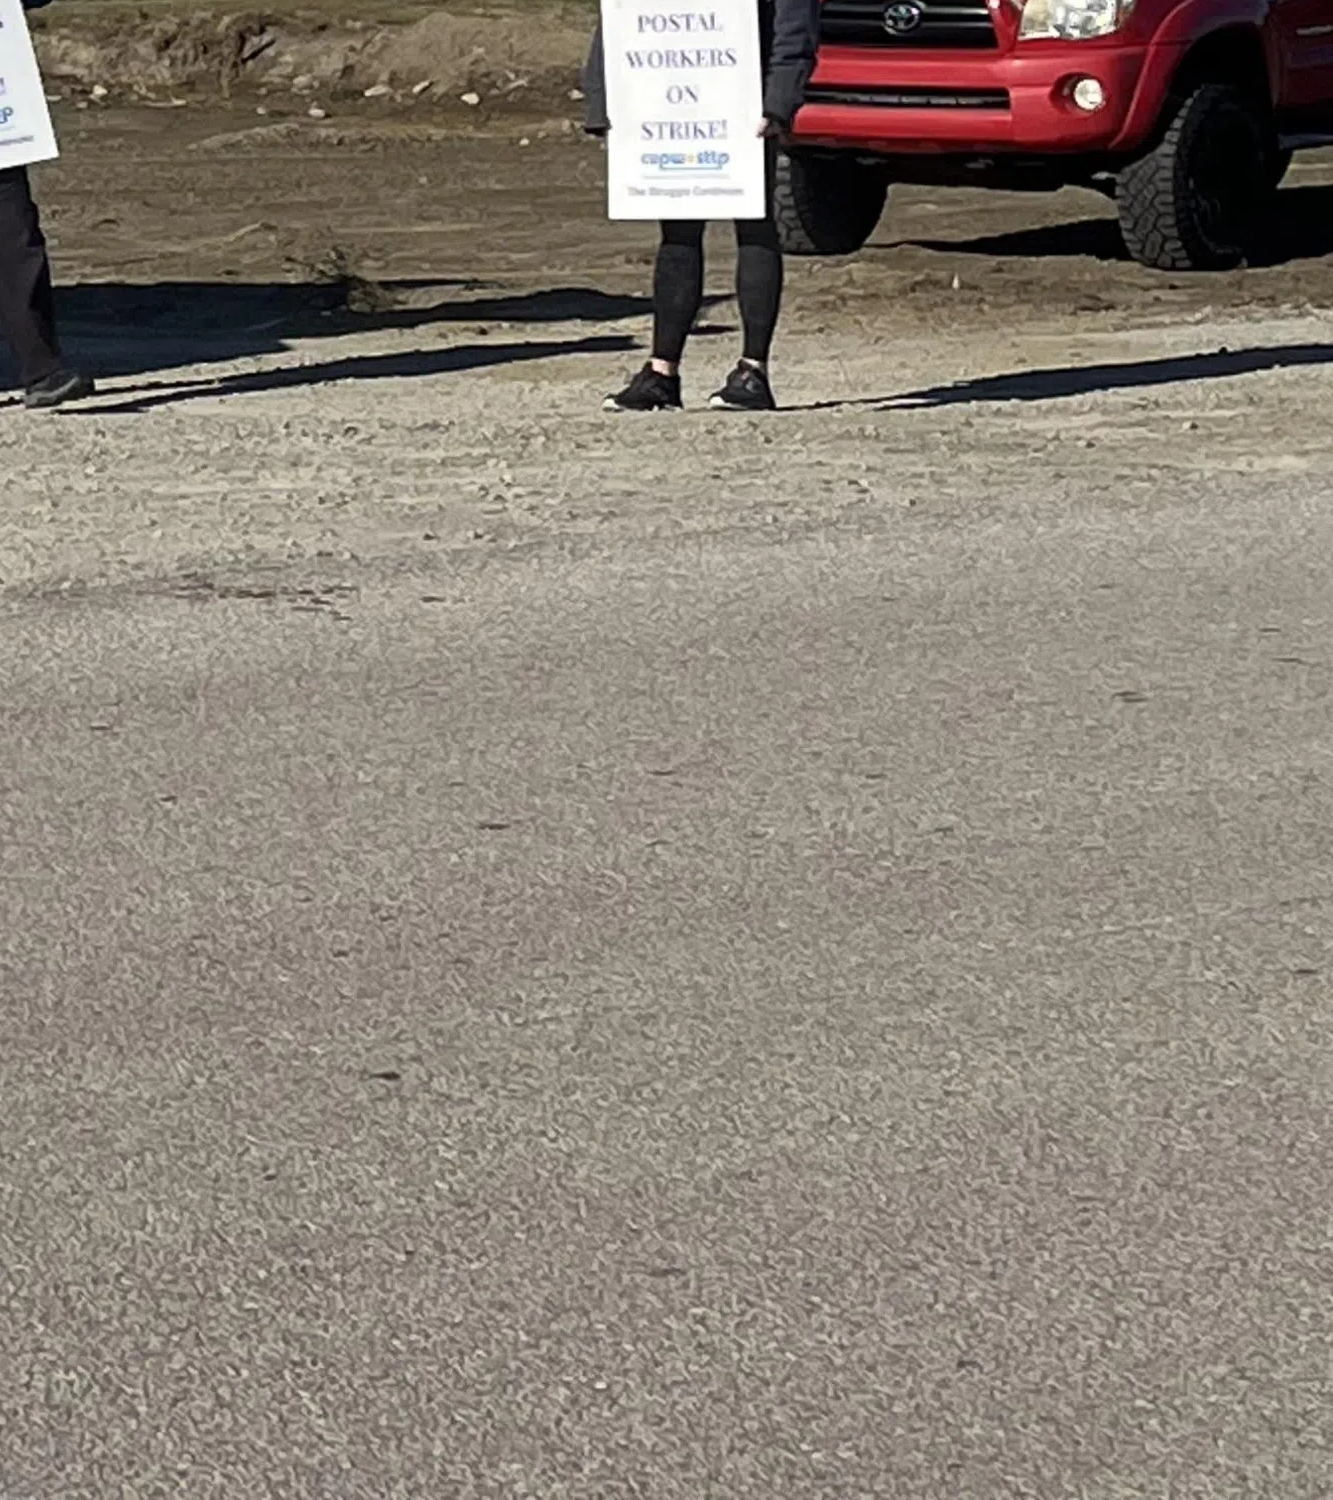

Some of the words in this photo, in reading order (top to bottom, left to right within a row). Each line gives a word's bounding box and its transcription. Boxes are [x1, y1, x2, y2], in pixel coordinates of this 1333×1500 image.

[637, 11, 724, 33] POSTAL
[625, 47, 737, 68] WORKERS
[666, 85, 700, 105] ON
[640, 119, 728, 140] STRIKE!
